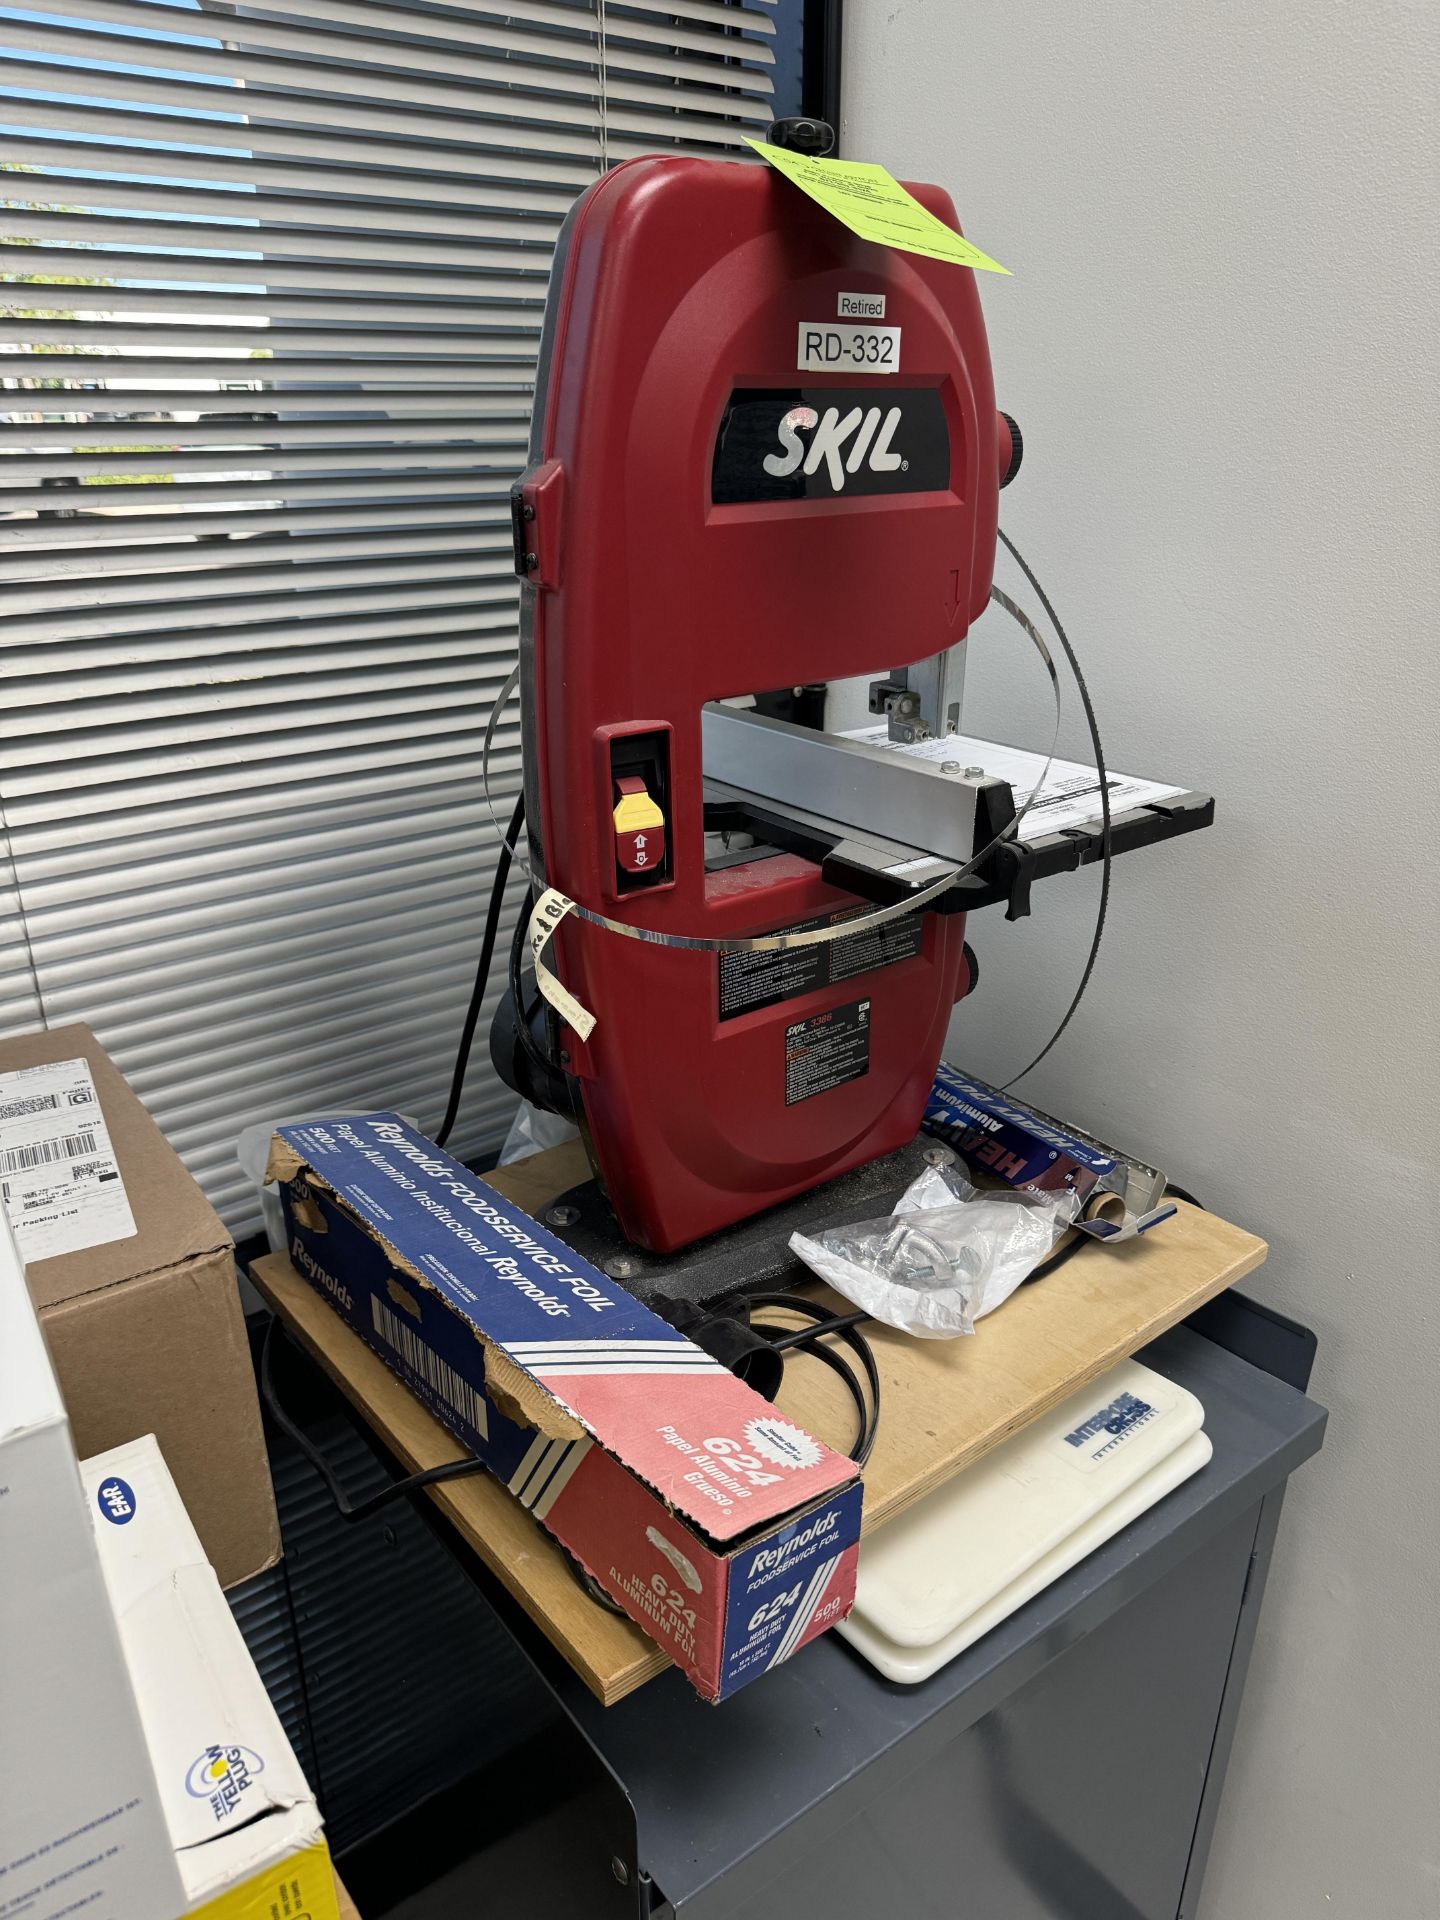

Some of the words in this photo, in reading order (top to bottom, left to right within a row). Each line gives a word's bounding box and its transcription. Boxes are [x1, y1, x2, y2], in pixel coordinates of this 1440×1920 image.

[841, 297, 883, 315] Retired
[805, 331, 893, 364] RD-332
[763, 407, 902, 492] SKIL
[786, 1022, 807, 1037] SKIL
[935, 1088, 1005, 1133] Aluminum
[988, 1104, 1076, 1148] HEAVY
[308, 1127, 337, 1144] 500
[331, 1123, 373, 1149] Papel
[359, 1150, 416, 1190] Aluminio
[409, 1190, 497, 1257] Institucional
[484, 1257, 569, 1317] Reynolds
[366, 1121, 451, 1178] Reynolds
[440, 1181, 574, 1274] FOODSERVICE
[557, 1277, 616, 1312] FOIL
[292, 1236, 353, 1310] Reynolds
[1092, 1408, 1160, 1461] INTERNATIONAL
[1104, 1398, 1152, 1435] CROSS
[656, 1425, 701, 1455] Papel
[690, 1454, 752, 1498] Aluminio
[702, 1437, 785, 1486] 624
[683, 1471, 734, 1506] Grueso
[746, 1543, 818, 1594] FOODSERVICE
[818, 1530, 840, 1550] FOIL
[747, 1511, 838, 1579] Reynolds
[609, 1566, 671, 1634] ALUMINUM
[673, 1631, 697, 1667] FOIL
[631, 1573, 668, 1615] HEAVY
[669, 1611, 696, 1648] DUTY
[651, 1573, 697, 1630] 624
[747, 1580, 804, 1632] 624
[813, 1596, 841, 1622] 500
[729, 1634, 767, 1661] ALUMINUM
[767, 1624, 782, 1637] FOIL
[749, 1624, 770, 1642] HEAVY
[769, 1613, 787, 1630] DUTY
[227, 1748, 253, 1791] PLUG
[209, 1794, 224, 1821] THE
